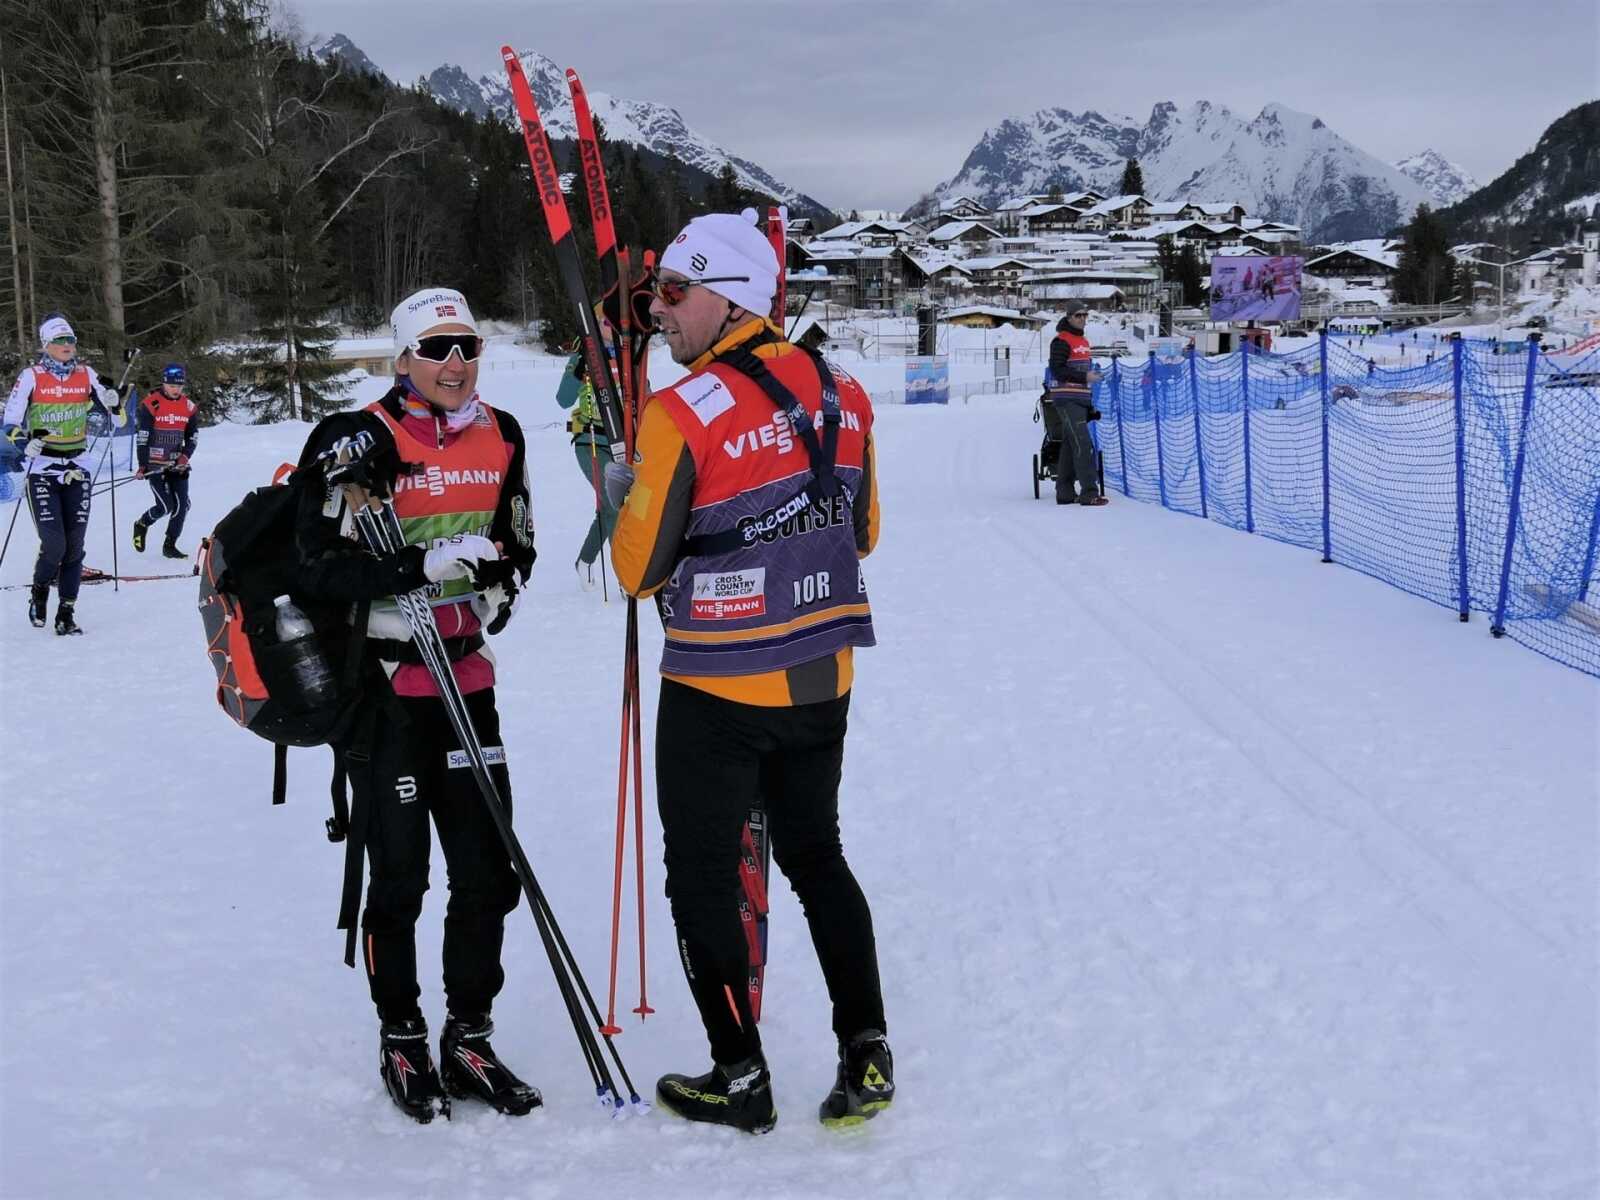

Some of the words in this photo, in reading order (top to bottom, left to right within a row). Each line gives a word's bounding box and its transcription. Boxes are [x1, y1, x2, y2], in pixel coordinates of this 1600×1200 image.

[523, 120, 561, 206] ATOMIC
[581, 139, 608, 222] ATOMIC
[40, 410, 73, 423] WARM
[714, 574, 743, 584] CROSS
[714, 580, 756, 591] COUNTRY
[739, 588, 754, 596] CUP
[695, 600, 760, 618] VIESSMANN
[665, 1079, 729, 1105] FISCHER
